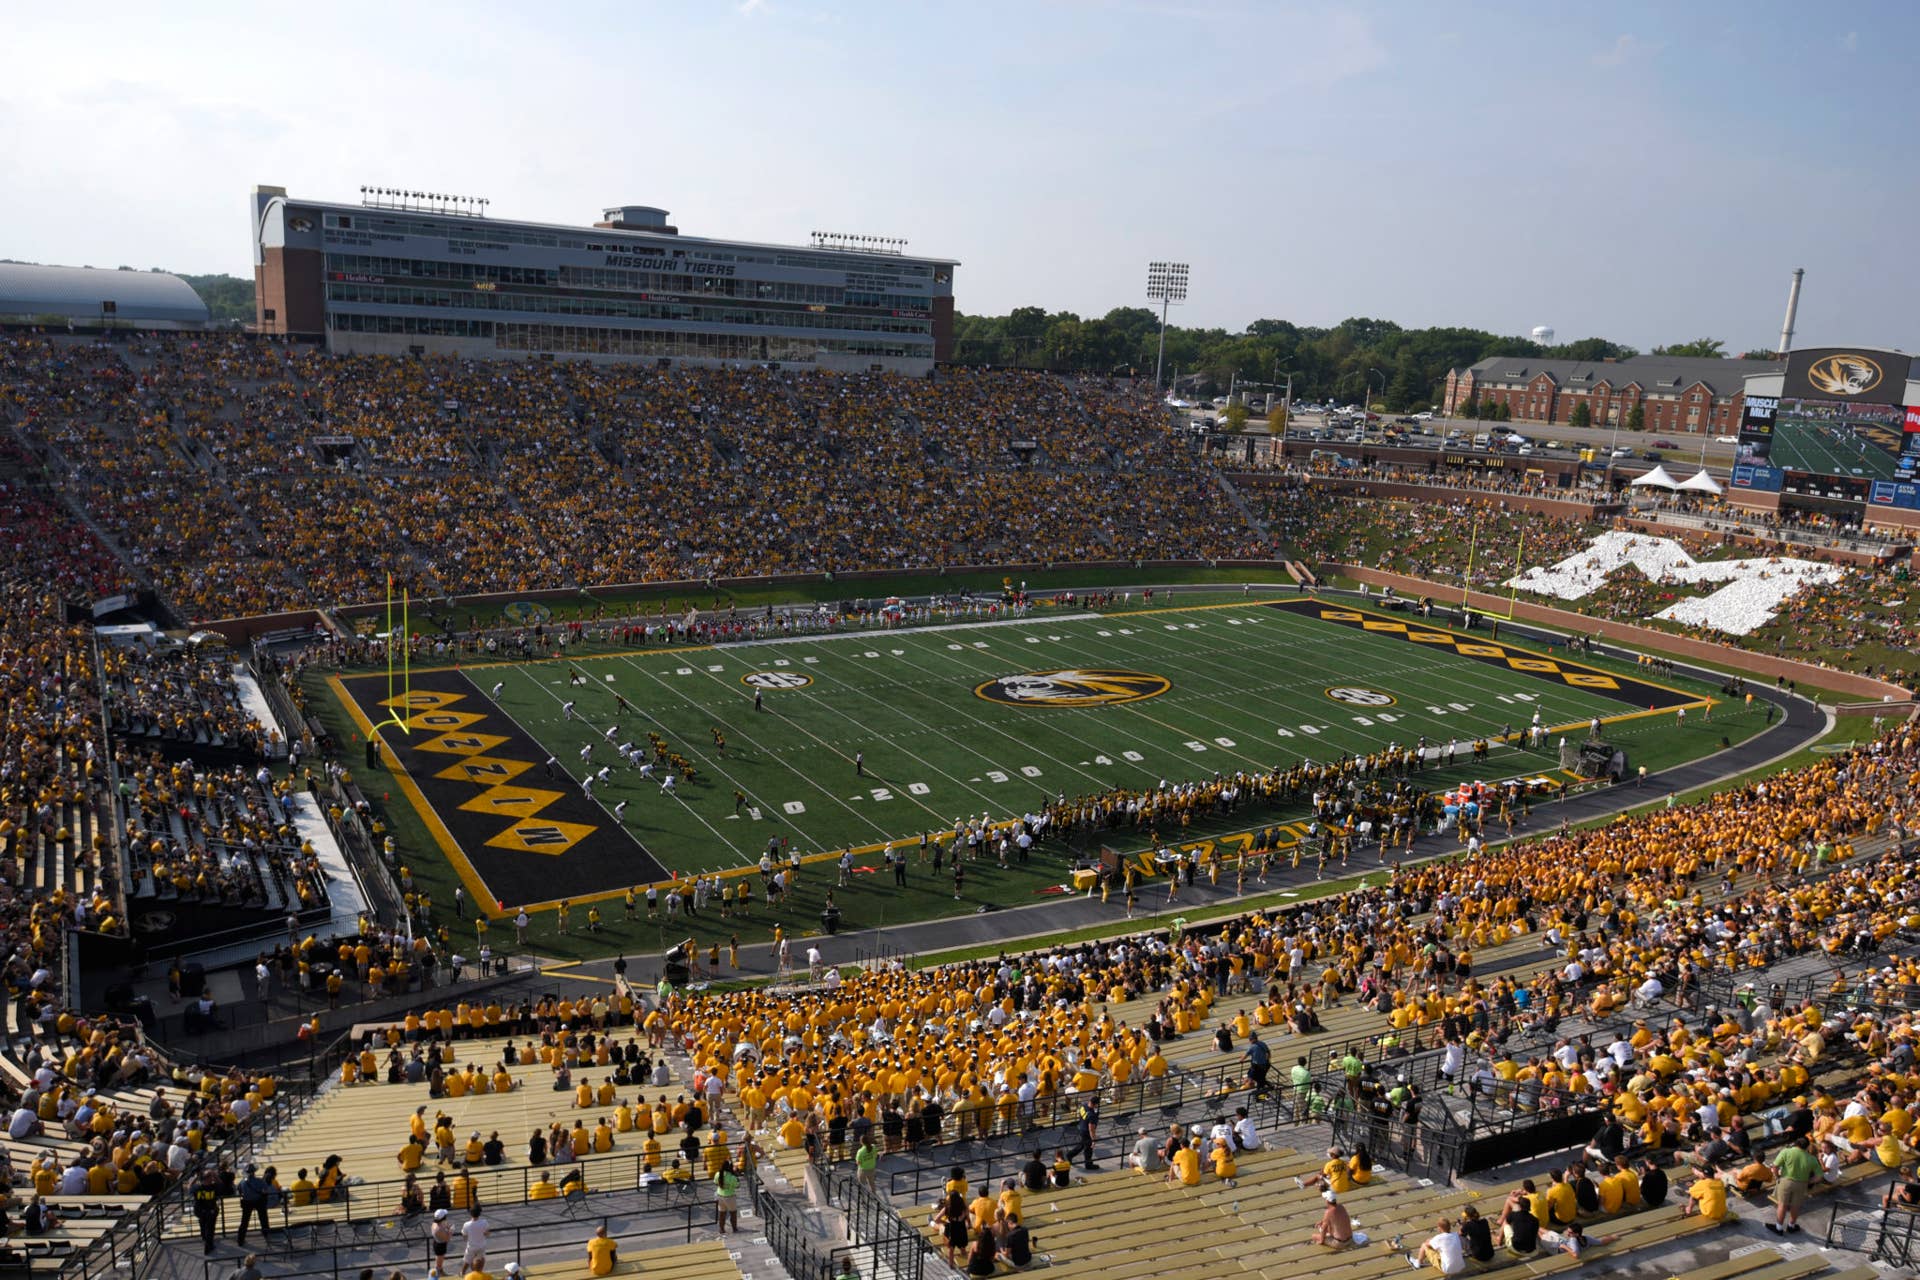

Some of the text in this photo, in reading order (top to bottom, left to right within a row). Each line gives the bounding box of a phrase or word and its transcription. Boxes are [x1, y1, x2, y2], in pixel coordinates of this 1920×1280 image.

[606, 255, 736, 276] MISSOURI TIGERS
[346, 273, 368, 282] Health
[1745, 397, 1779, 409] MUSCLE
[1749, 407, 1771, 418] MILK
[1496, 692, 1535, 704] 10
[1425, 702, 1470, 716] 20
[1352, 713, 1398, 727] 30
[1277, 724, 1321, 738] 40
[1183, 737, 1237, 752] 50
[1095, 750, 1144, 766] 40
[985, 765, 1043, 783] 30
[870, 782, 931, 802] 20
[746, 800, 806, 821] 10
